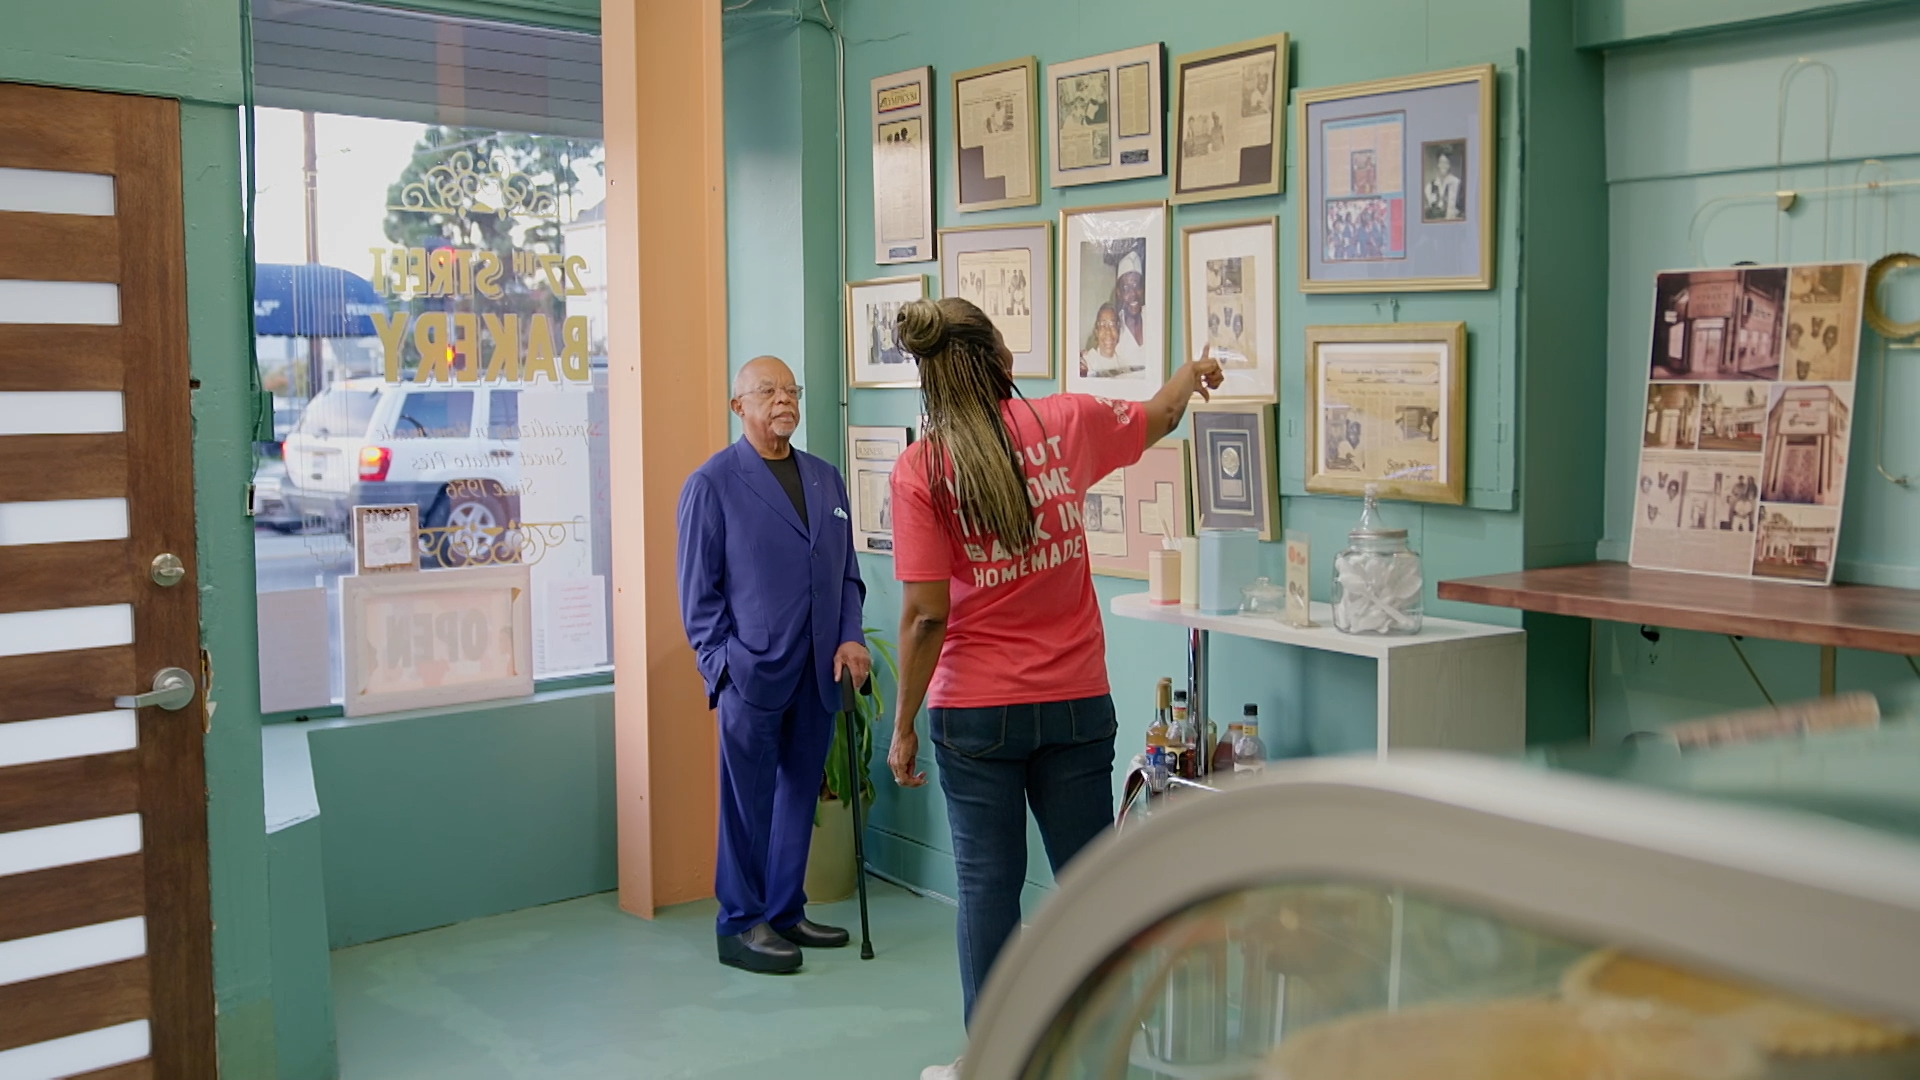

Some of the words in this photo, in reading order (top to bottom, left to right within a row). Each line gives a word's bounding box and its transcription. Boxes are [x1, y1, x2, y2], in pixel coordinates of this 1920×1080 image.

[1026, 467, 1076, 508] OME
[1057, 501, 1083, 532] IN
[972, 535, 1083, 588] HOMEMADE
